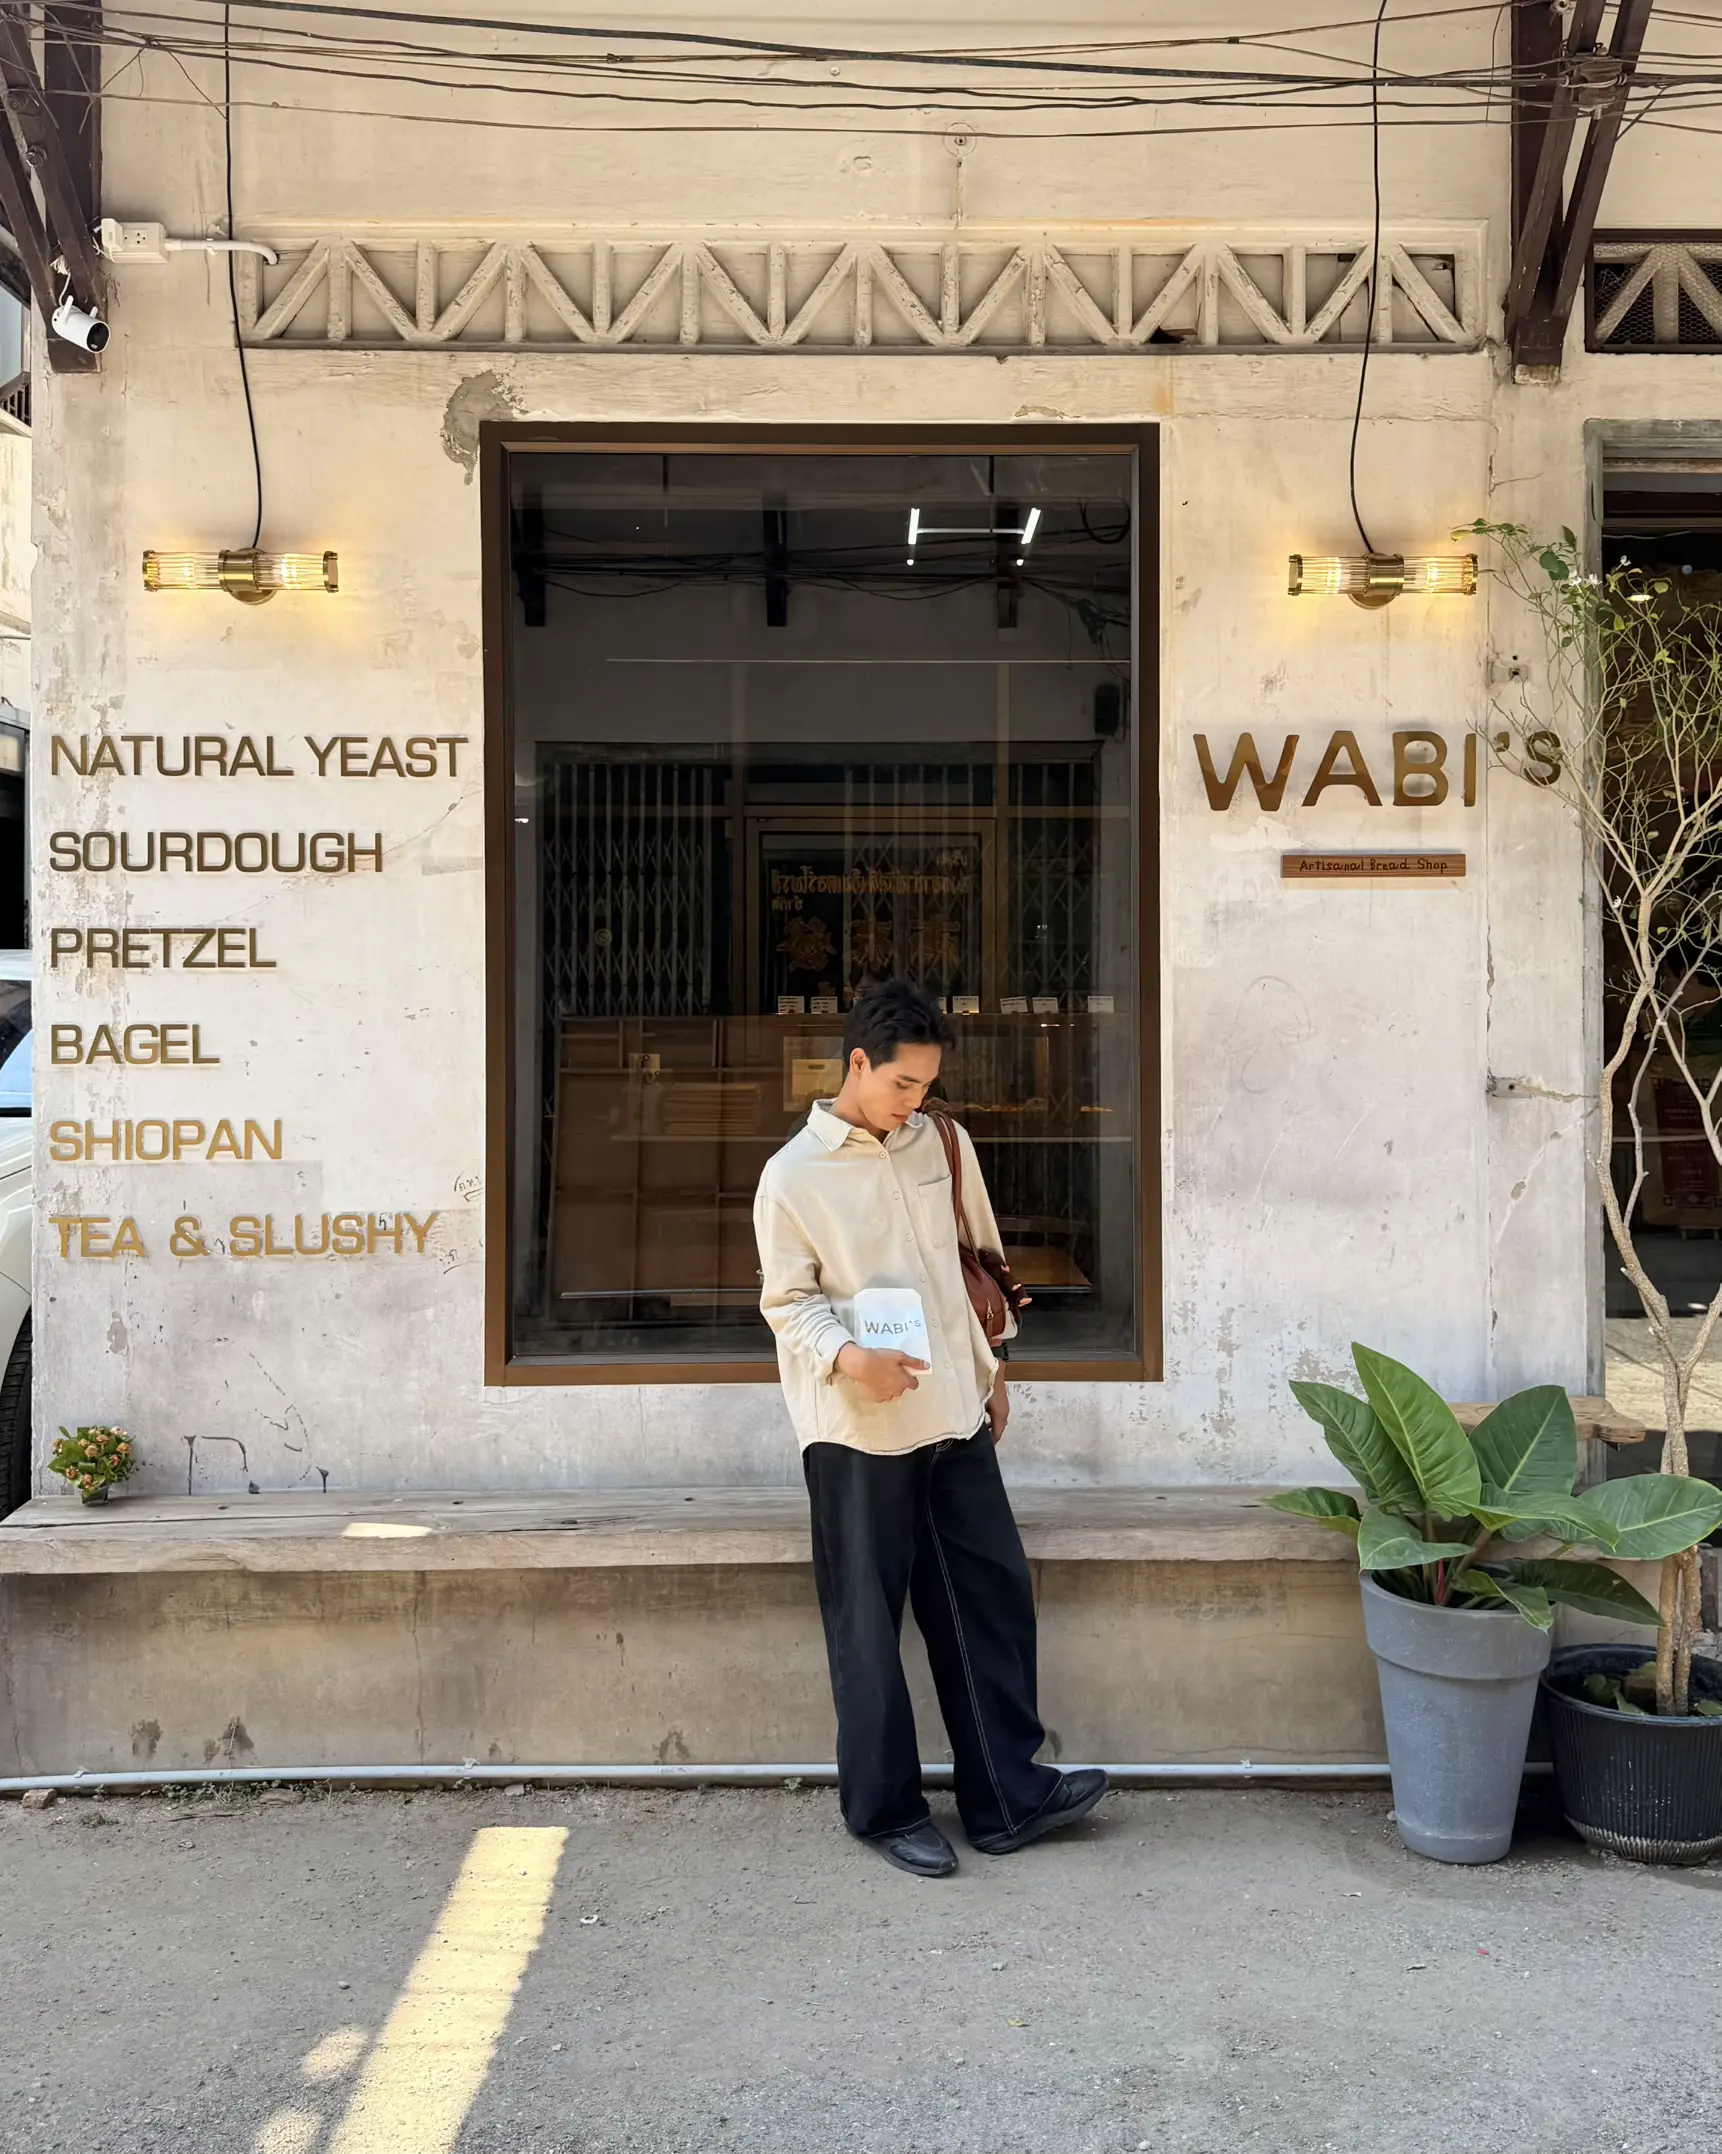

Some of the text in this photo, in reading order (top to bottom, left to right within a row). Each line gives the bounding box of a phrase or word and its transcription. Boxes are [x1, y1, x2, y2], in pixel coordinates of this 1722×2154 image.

[50, 735, 469, 778] NATURAL YEAST
[49, 831, 383, 873] SOURDOUGH
[1300, 857, 1448, 874] Artisanal Bread Shop
[50, 928, 277, 969] PRETZEL
[50, 1024, 220, 1065] BAGEL
[49, 1119, 283, 1161] SHIOPAN
[49, 1212, 440, 1258] TEA & SLUSHY
